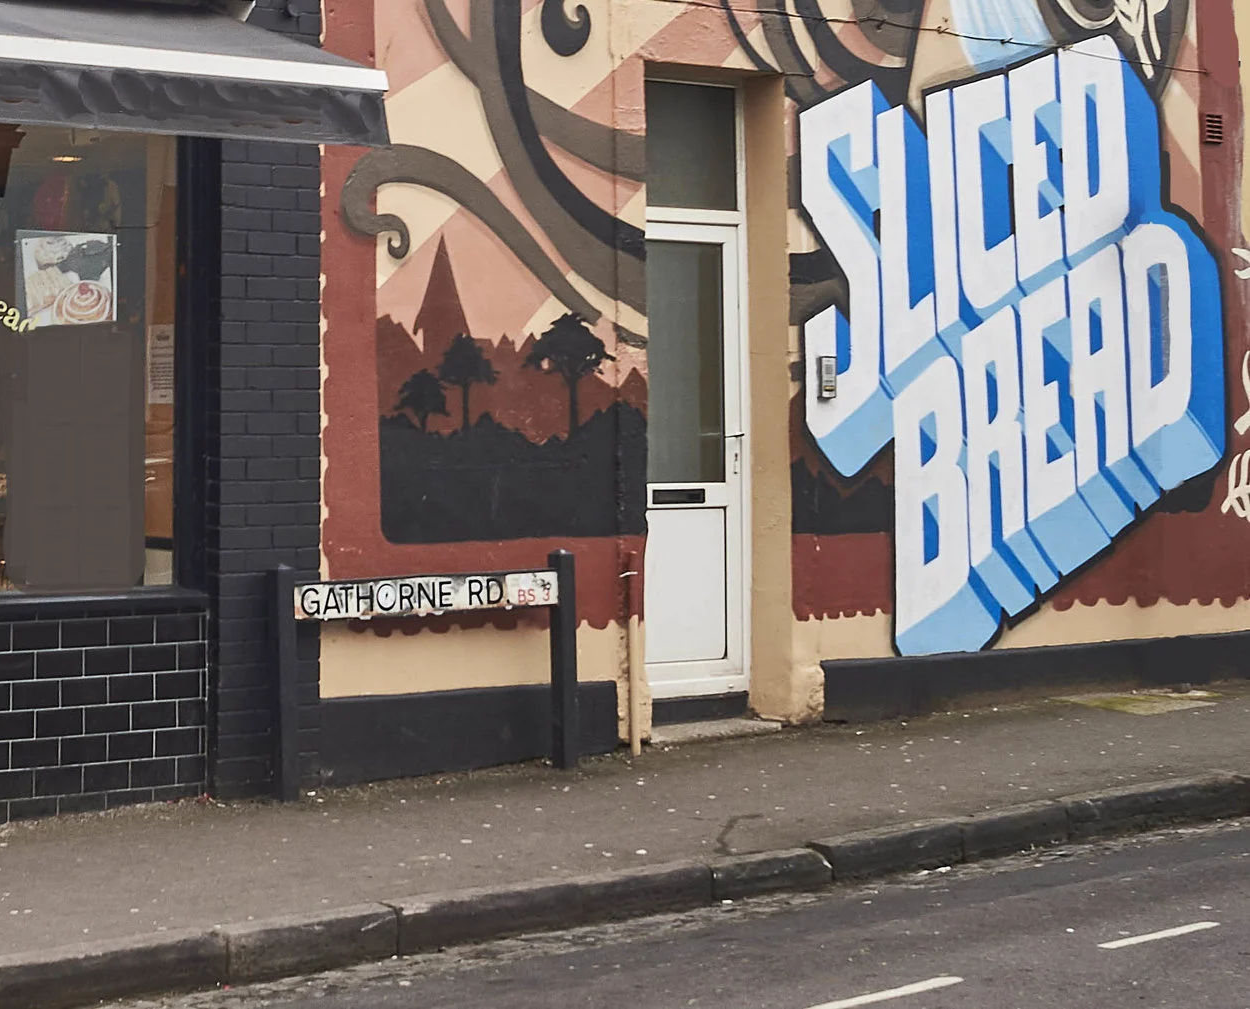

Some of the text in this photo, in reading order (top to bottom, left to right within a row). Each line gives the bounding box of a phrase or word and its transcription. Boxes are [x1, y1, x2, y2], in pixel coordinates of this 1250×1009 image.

[800, 35, 1132, 438] SLICED
[894, 222, 1196, 637] BREAD
[300, 580, 453, 616] GATHORNE
[517, 589, 536, 605] BS
